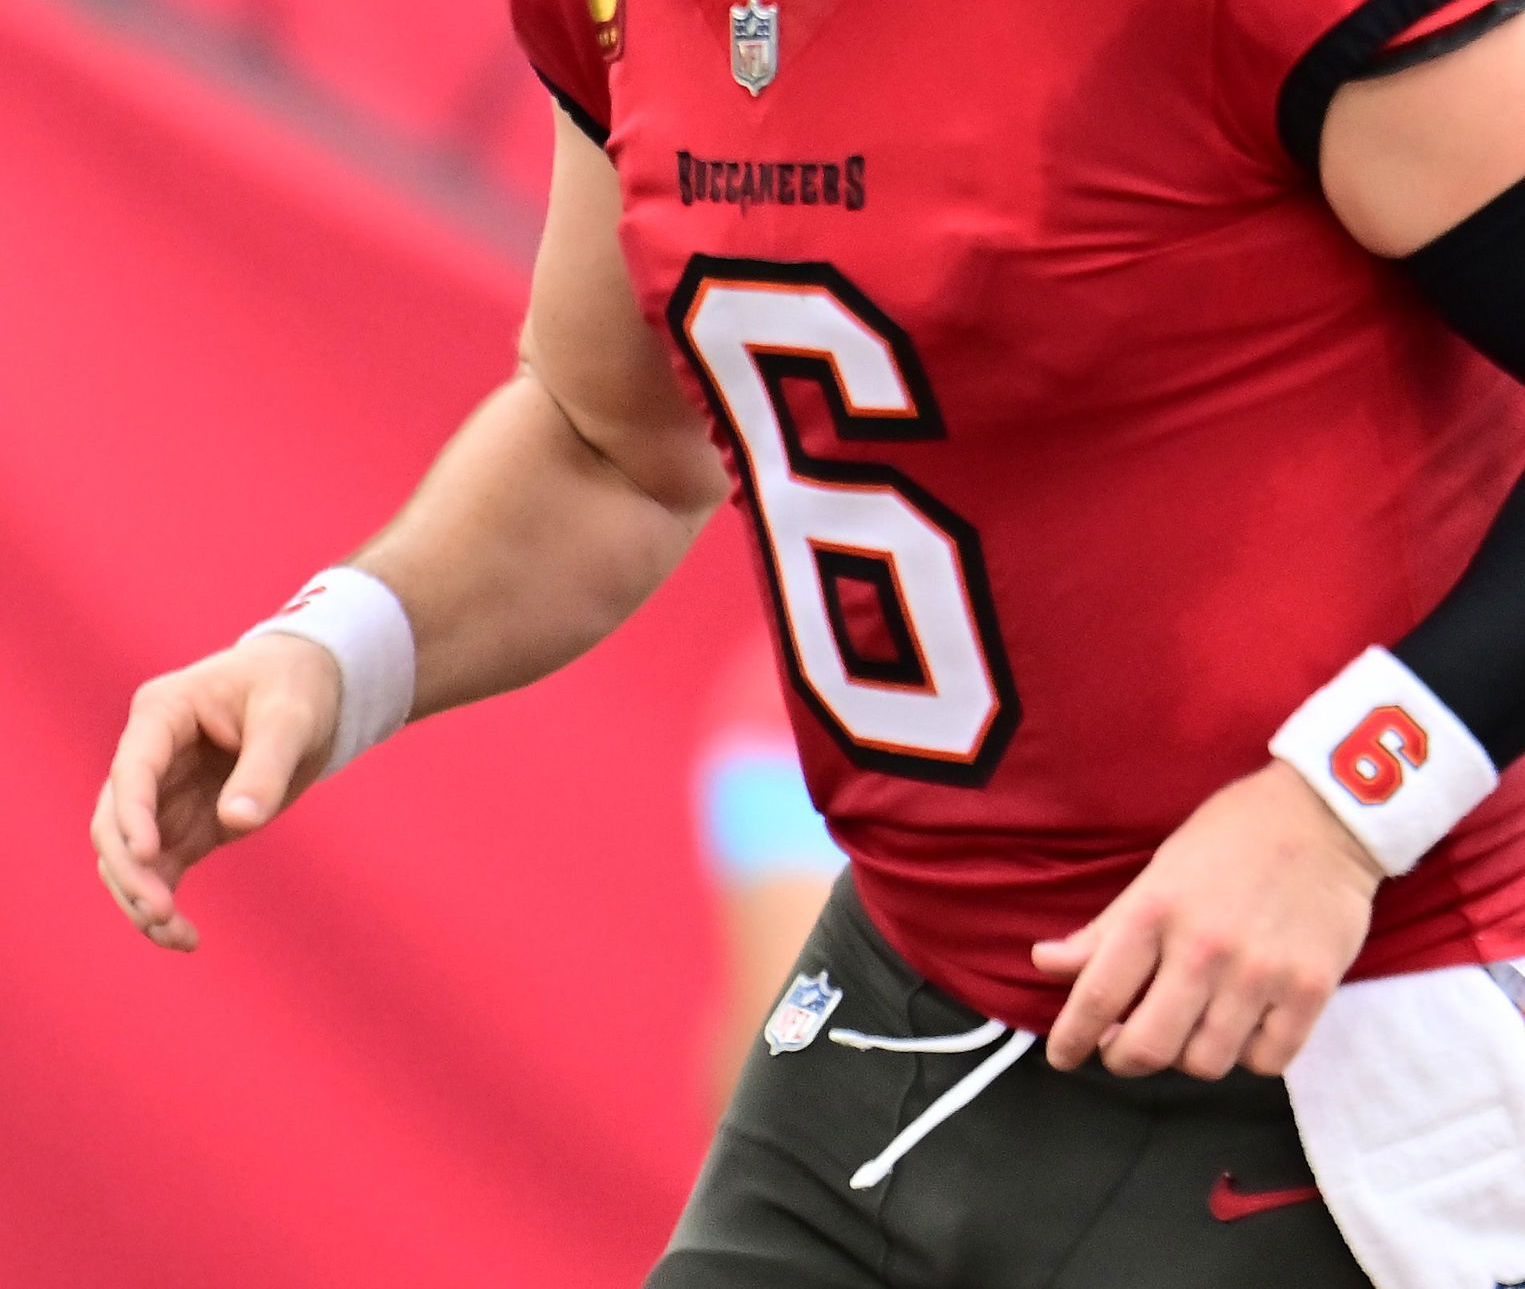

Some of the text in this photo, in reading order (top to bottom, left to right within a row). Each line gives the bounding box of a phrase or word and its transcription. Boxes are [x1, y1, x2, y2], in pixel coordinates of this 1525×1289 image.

[675, 149, 867, 217] BUCCANEERS
[667, 252, 1023, 788] 6
[1328, 704, 1430, 806] 6
